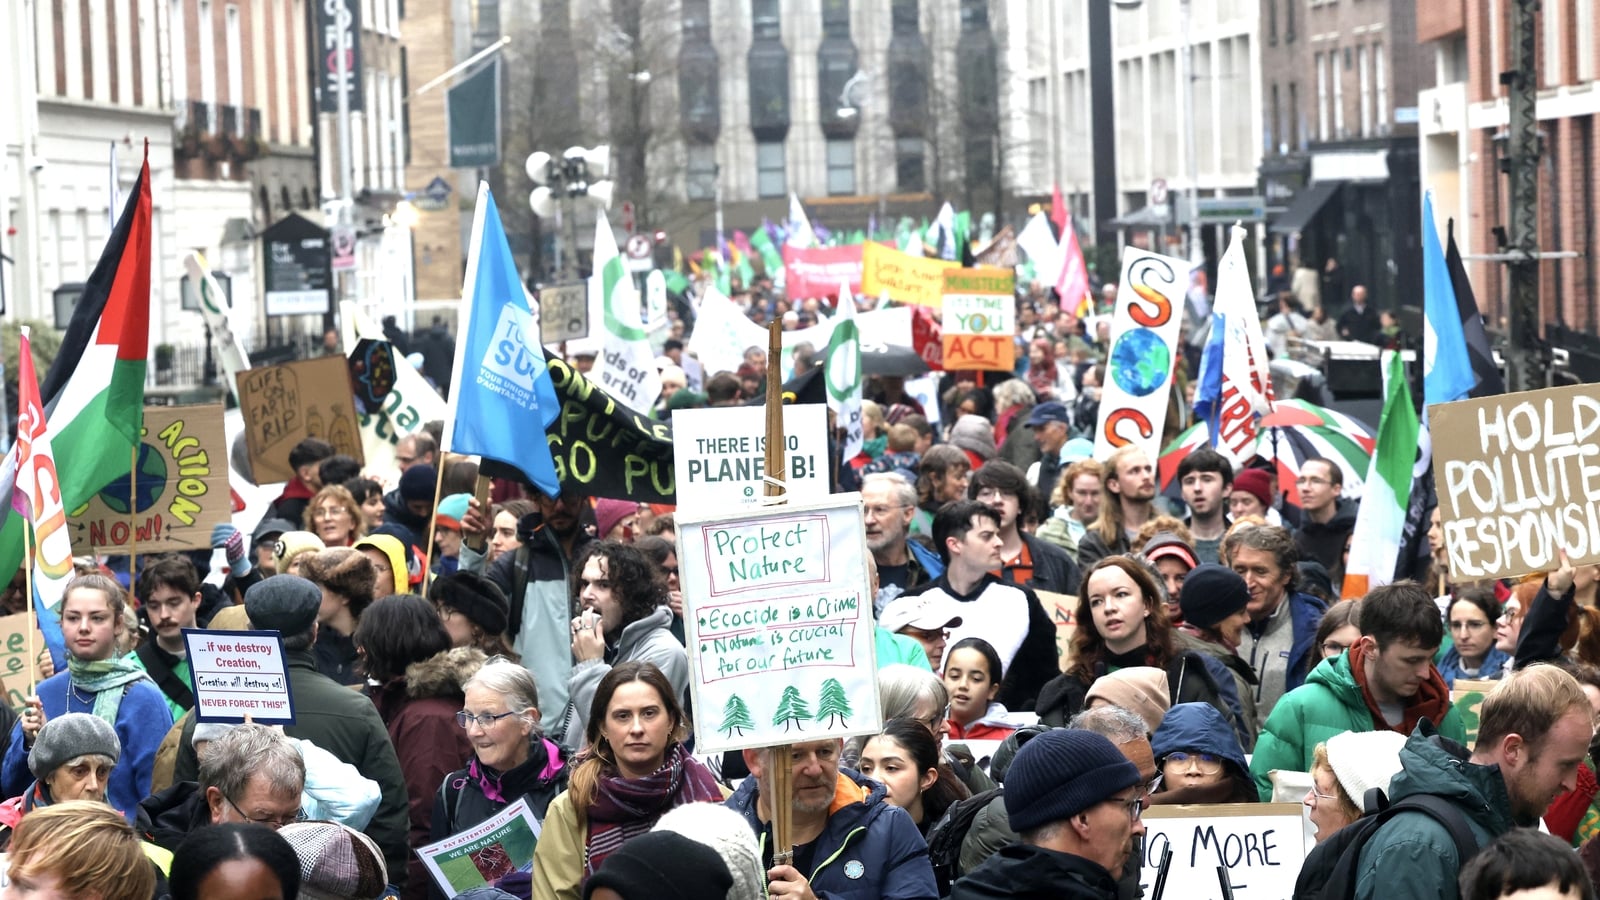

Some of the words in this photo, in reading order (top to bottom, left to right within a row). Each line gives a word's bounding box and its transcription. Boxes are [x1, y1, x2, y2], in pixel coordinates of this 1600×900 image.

[956, 312, 1003, 333] YOU
[947, 336, 1006, 360] ACT
[250, 367, 283, 393] LIFE
[480, 367, 502, 385] YOUR
[504, 381, 530, 399] UNION
[602, 371, 637, 401] arth
[628, 367, 648, 383] of
[262, 409, 296, 443] RIP
[1478, 395, 1600, 454] HOLD
[696, 437, 750, 454] THERE
[158, 419, 210, 526] ACTION
[688, 456, 765, 483] PLANE
[792, 454, 815, 479] B!
[1444, 443, 1600, 519] POLLUTE
[90, 513, 162, 546] NOW!
[713, 523, 808, 556] Protect
[1443, 500, 1600, 578] RESPONSI
[729, 555, 806, 582] Nature
[709, 605, 778, 629] Ecocide
[789, 606, 801, 623] is
[807, 605, 814, 618] a
[817, 596, 857, 619] Crime
[217, 644, 232, 652] we
[234, 642, 272, 656] destroy
[713, 634, 765, 654] Nature
[771, 630, 783, 645] is
[789, 618, 845, 643] crucial
[215, 657, 261, 670] Creation,
[718, 653, 741, 677] for
[746, 653, 776, 670] our
[783, 647, 834, 671] future
[199, 676, 228, 687] Creation
[230, 676, 240, 687] will
[244, 677, 269, 691] destroy
[271, 678, 283, 688] us!
[201, 698, 227, 707] NEVER
[229, 699, 259, 708] FORGET
[442, 841, 457, 849] PAY
[458, 822, 496, 843] ATTENTION
[449, 850, 462, 859] WE
[463, 844, 480, 854] ARE
[480, 825, 512, 847] NATURE
[1190, 825, 1280, 868] MORE
